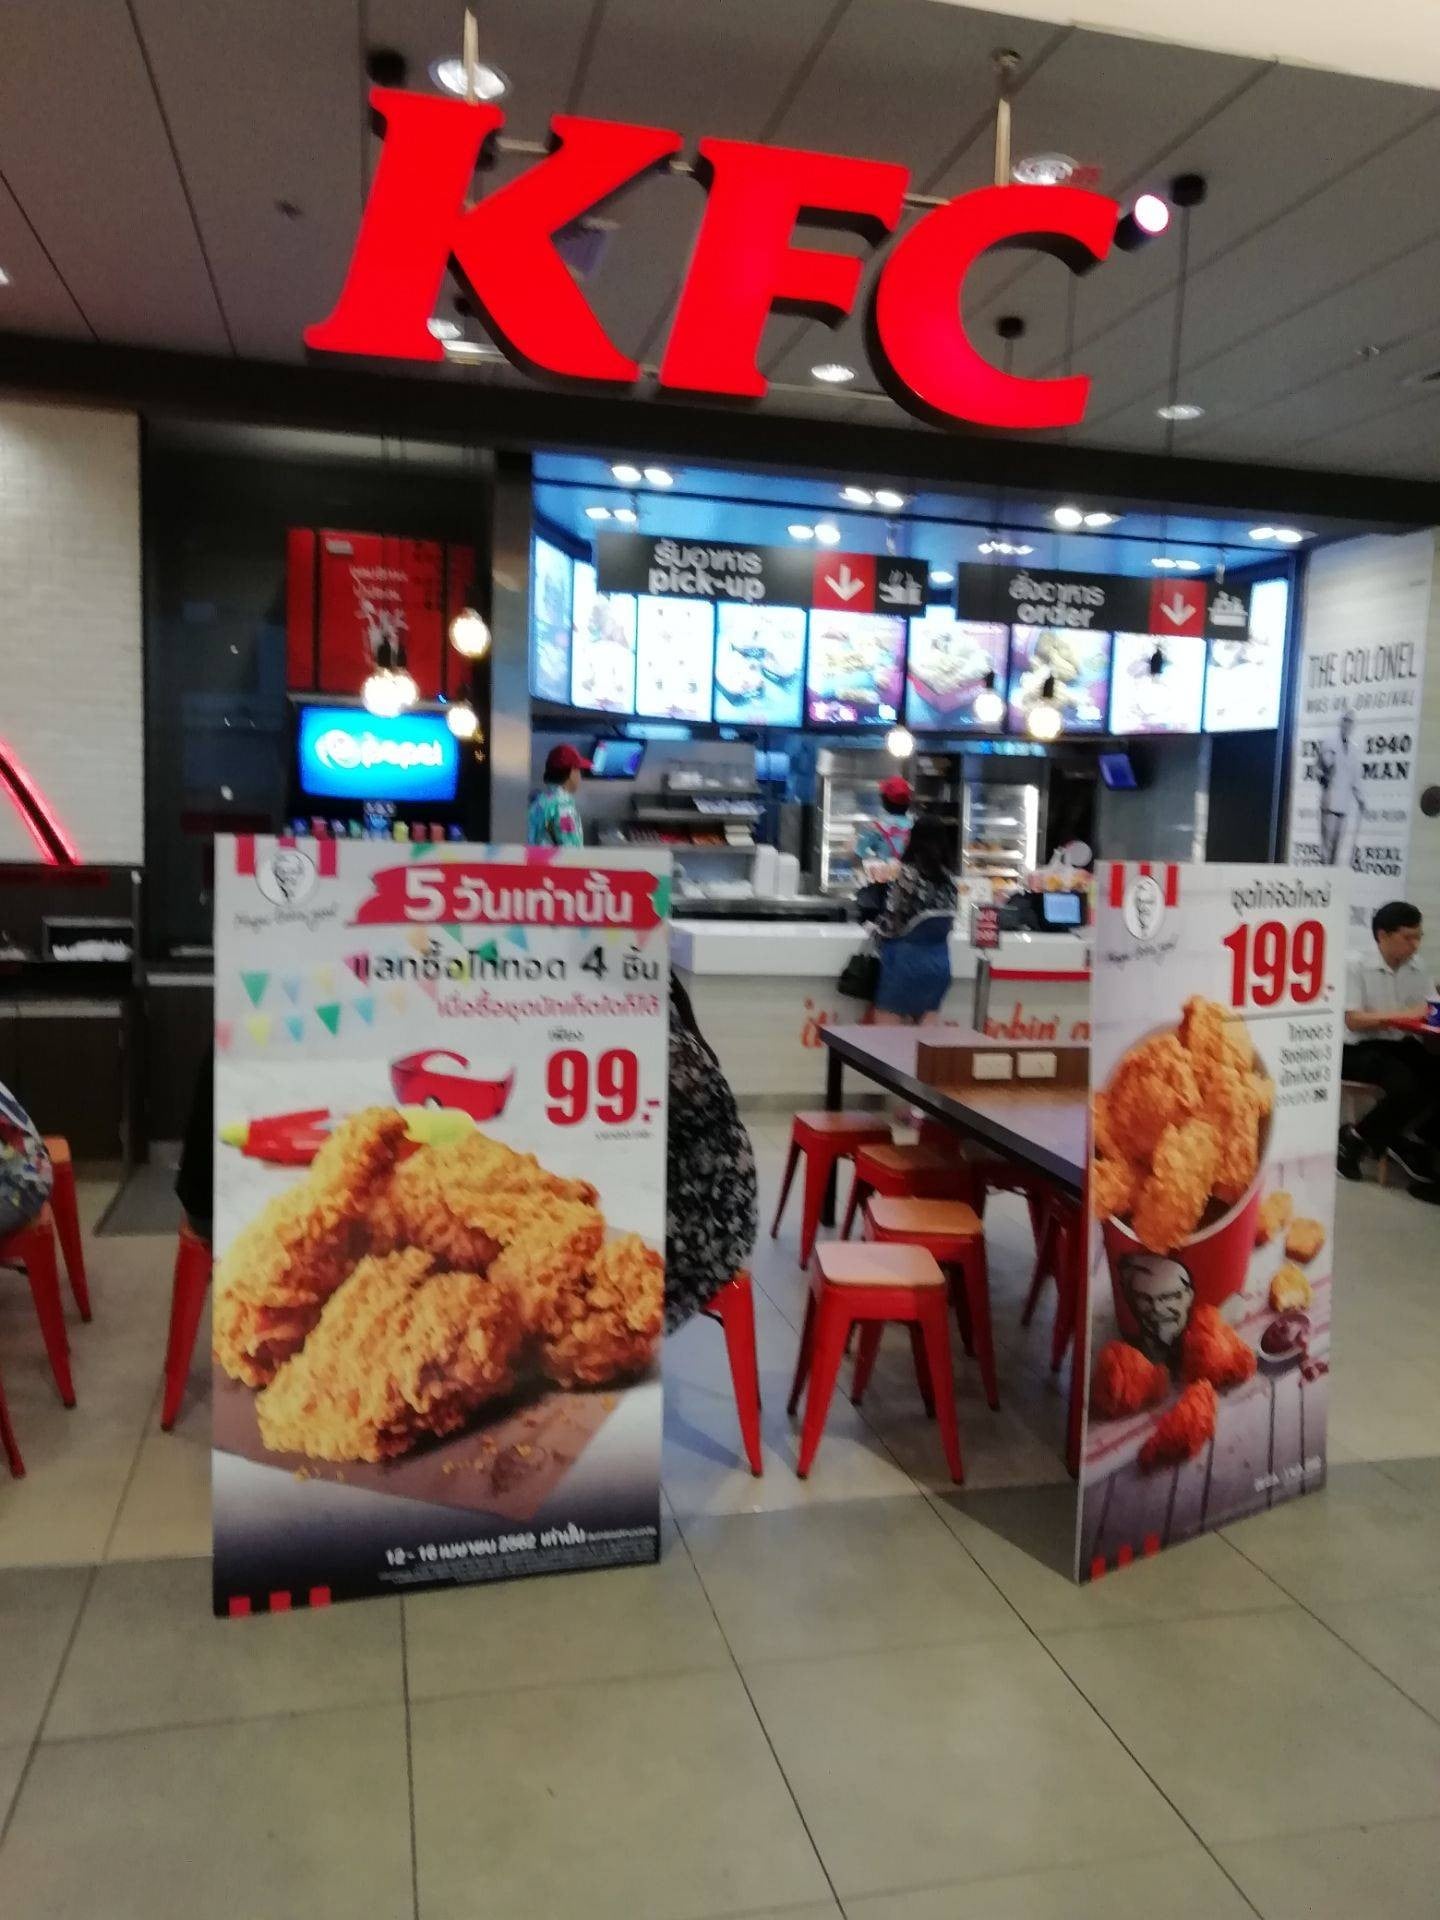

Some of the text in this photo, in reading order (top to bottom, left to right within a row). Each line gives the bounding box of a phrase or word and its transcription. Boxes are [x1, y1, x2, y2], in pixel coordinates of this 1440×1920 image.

[304, 87, 1119, 430] KFC
[648, 567, 766, 603] pick-up
[1017, 600, 1094, 628] order
[1307, 642, 1417, 689] THE COLONEL
[1364, 733, 1413, 755] 1940
[1361, 761, 1411, 781] MAN
[404, 868, 633, 923] 5 วันเท่านั้น
[580, 946, 608, 980] 4
